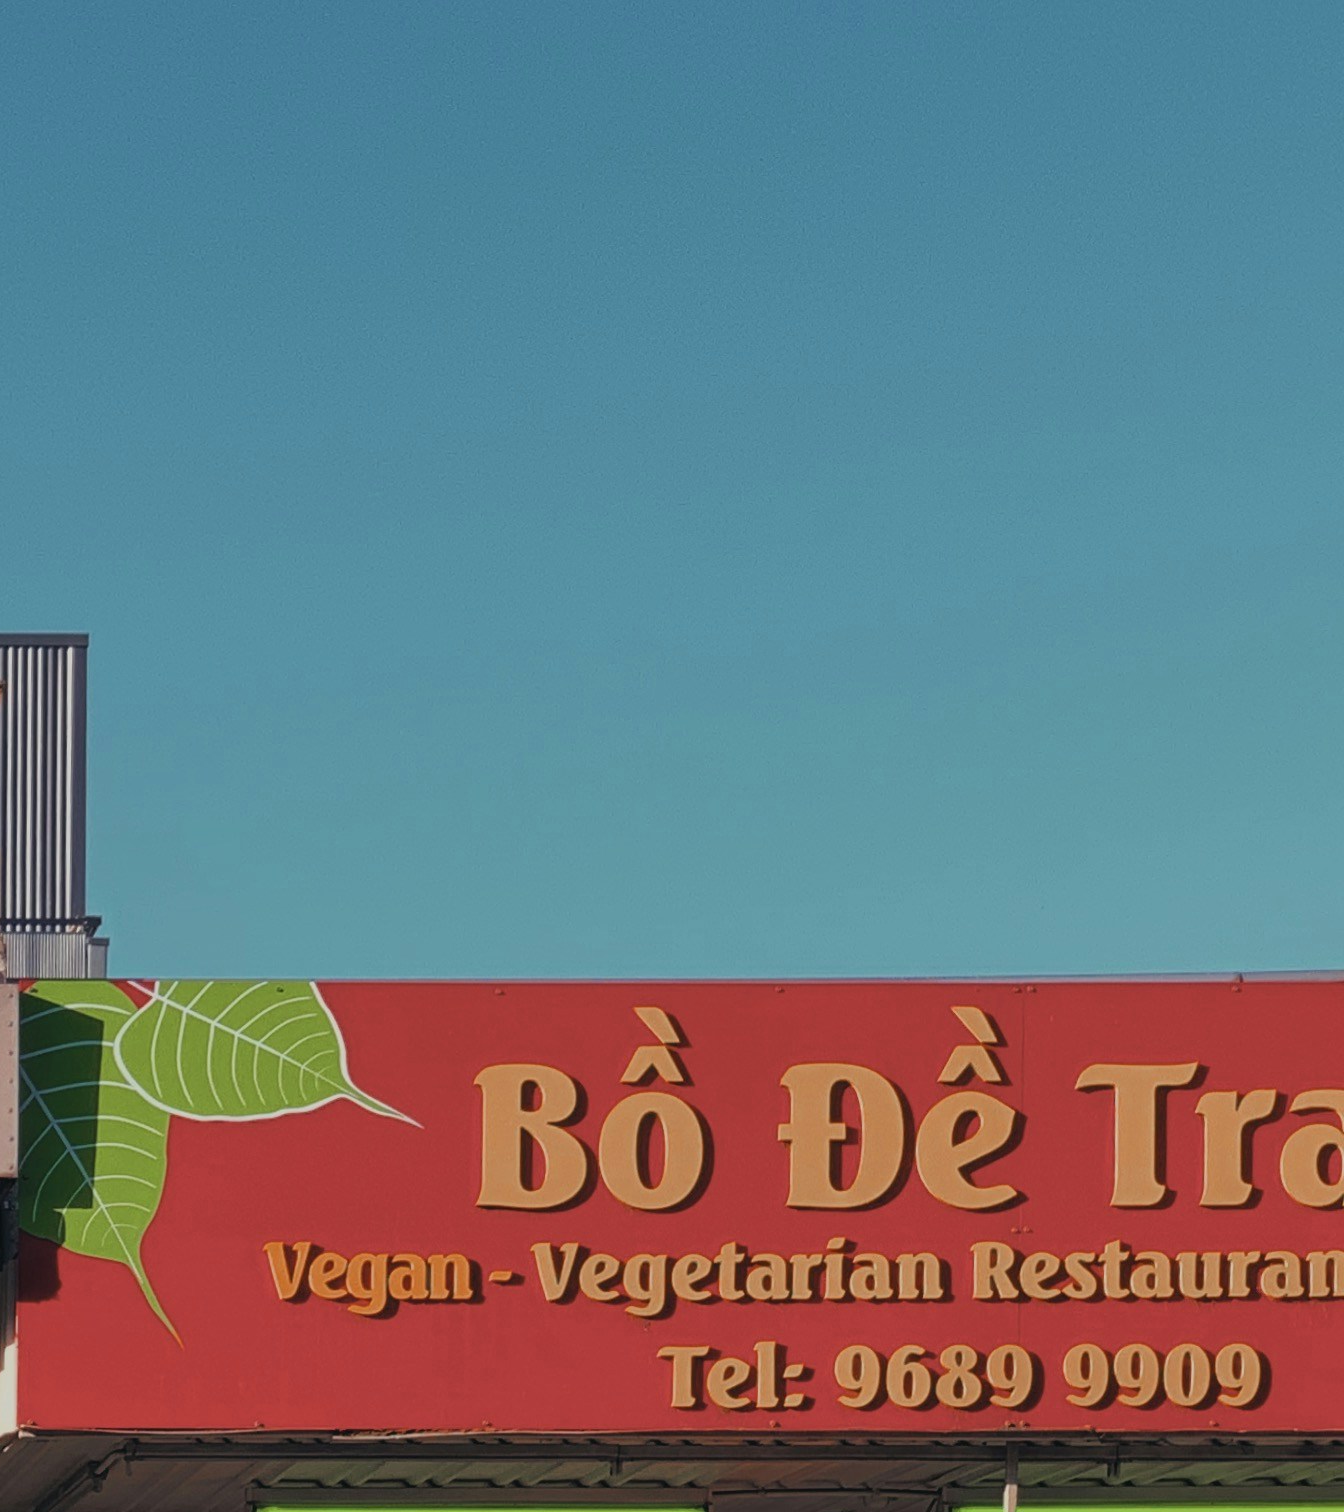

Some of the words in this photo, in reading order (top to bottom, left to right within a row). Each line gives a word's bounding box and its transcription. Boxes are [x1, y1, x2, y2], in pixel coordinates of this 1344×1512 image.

[473, 1006, 705, 1210] Bồ
[778, 1006, 1018, 1210] Đề
[263, 1240, 474, 1318] Vegan
[531, 1237, 945, 1318] Vegetarian
[970, 1239, 1344, 1301] Restauran
[656, 1341, 804, 1409] Tel:
[833, 1343, 1033, 1409] 9689
[1062, 1343, 1262, 1409] 9909
